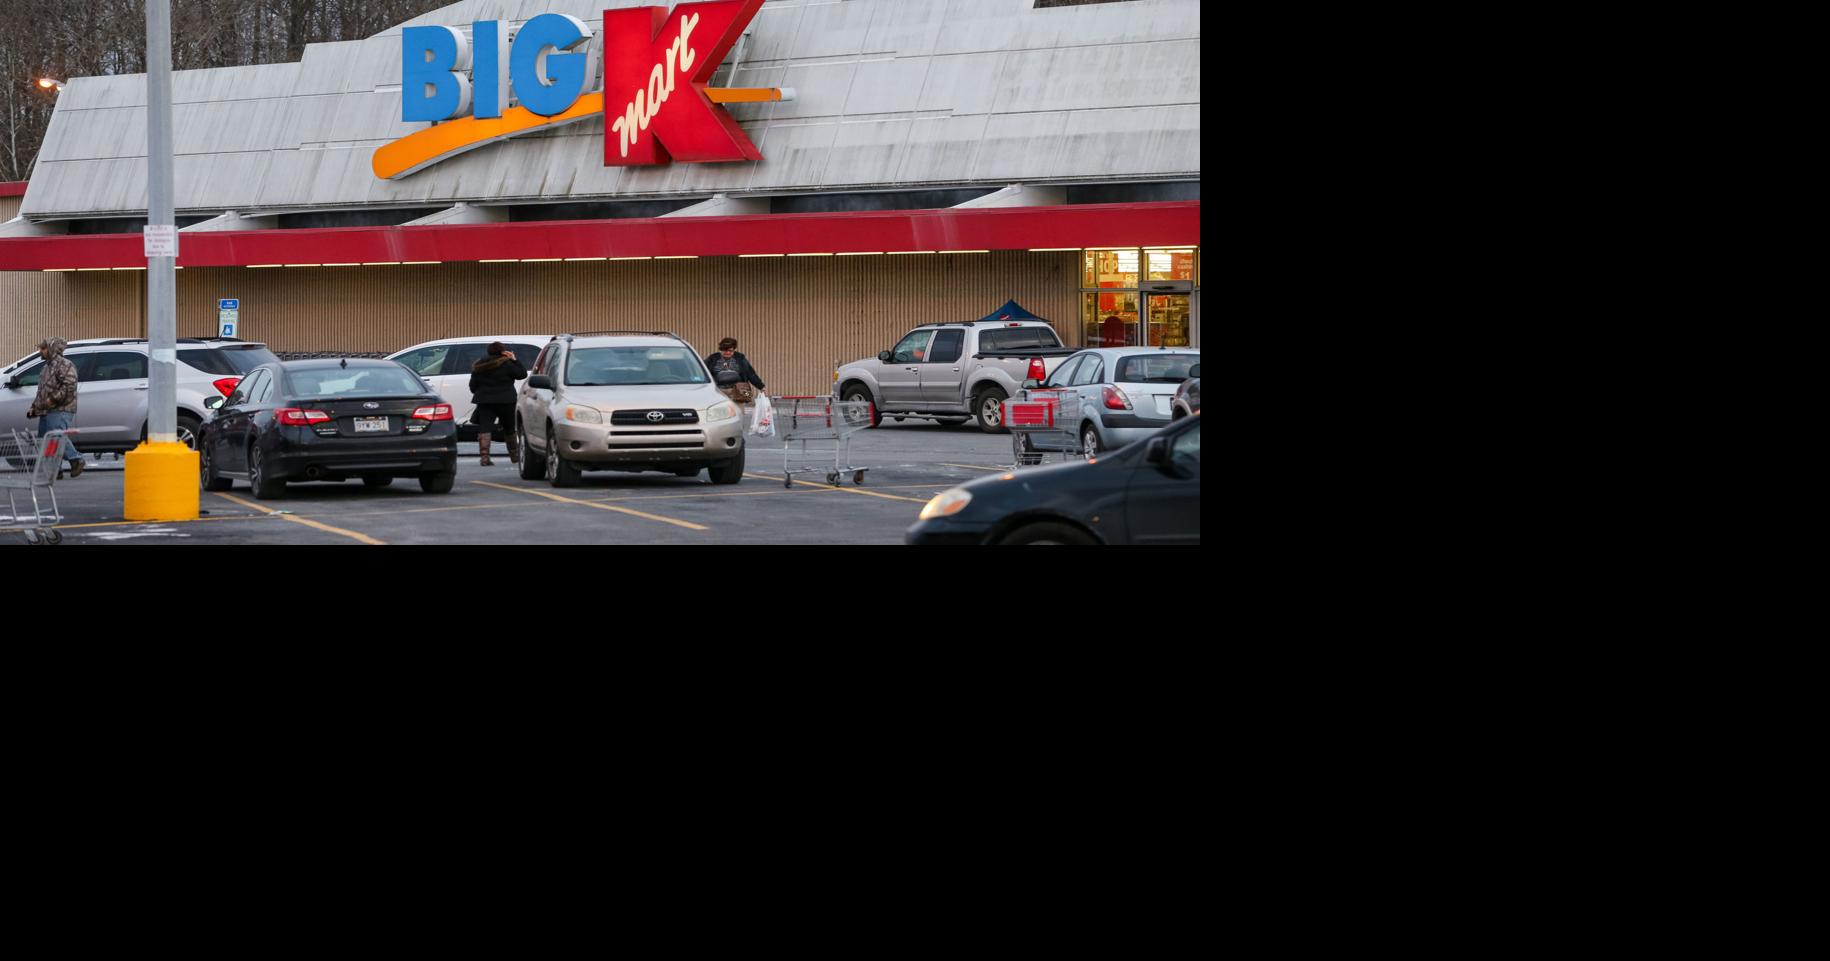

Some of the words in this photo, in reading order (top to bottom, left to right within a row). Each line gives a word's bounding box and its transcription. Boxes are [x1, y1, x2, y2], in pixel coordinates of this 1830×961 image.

[402, 13, 592, 121] BIG
[603, 0, 765, 166] K
[612, 12, 699, 157] mart
